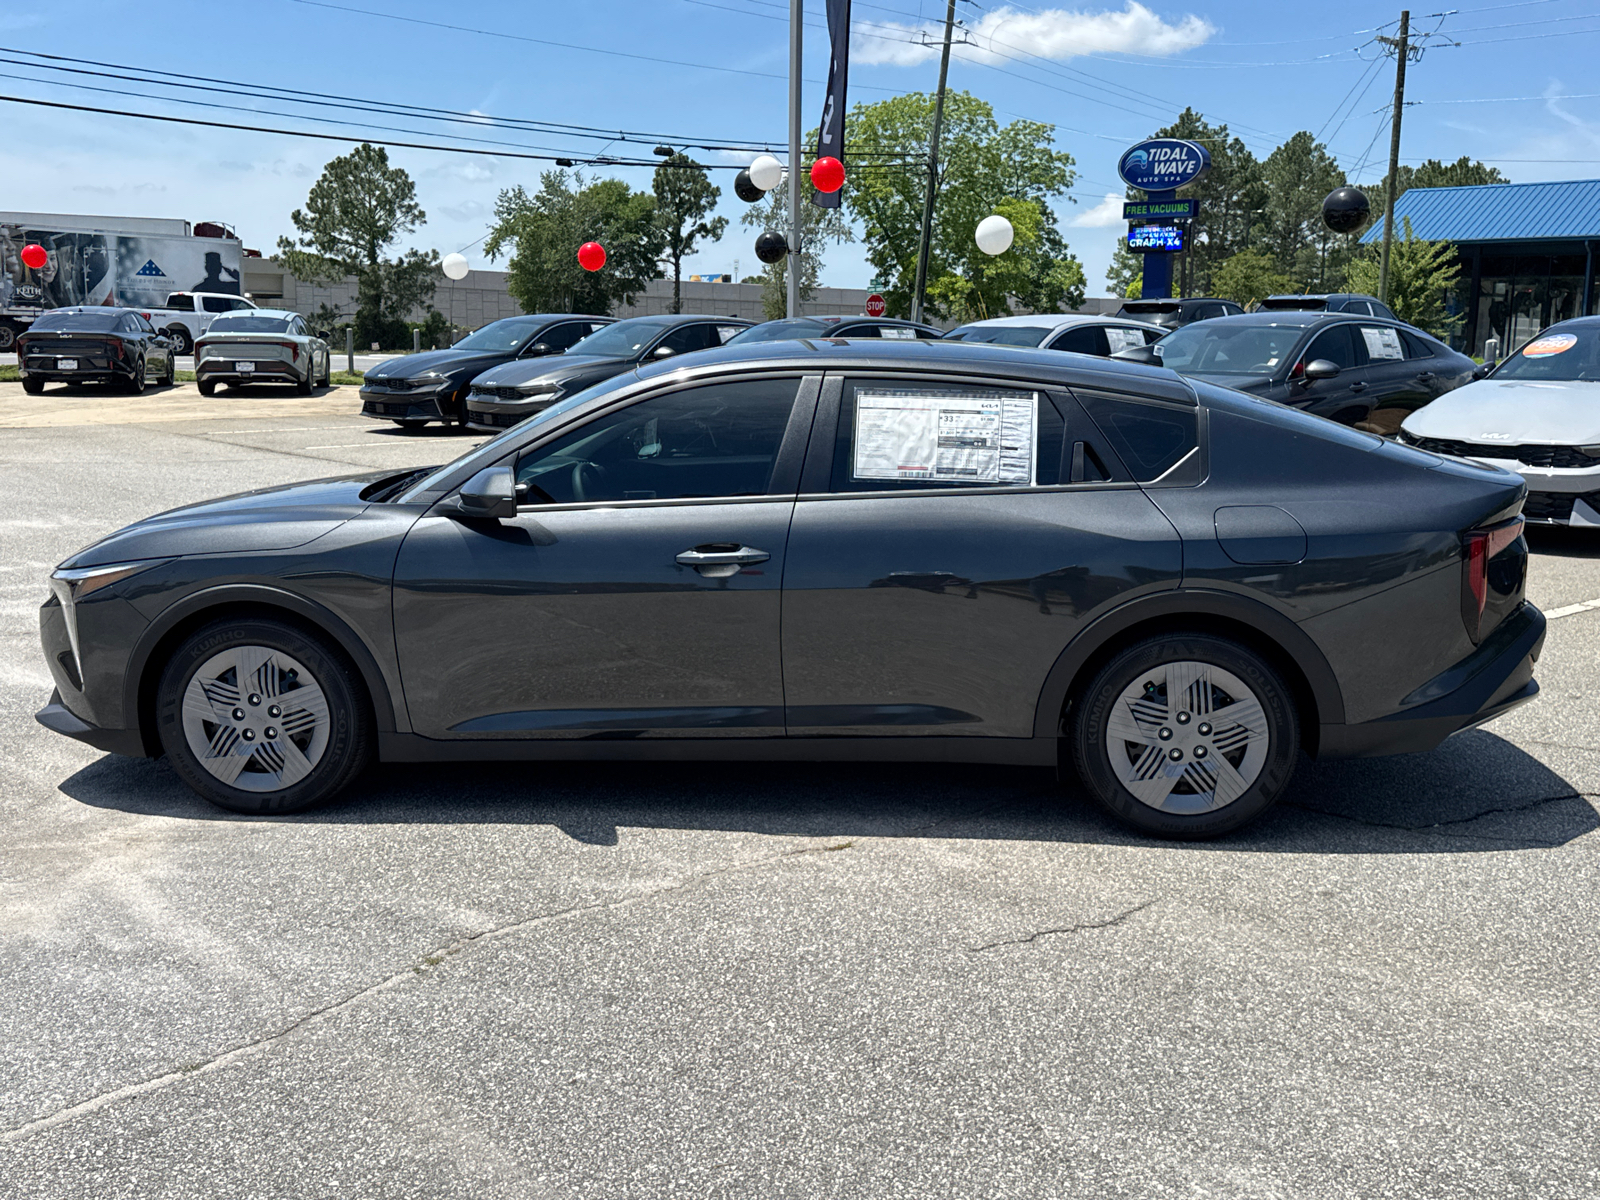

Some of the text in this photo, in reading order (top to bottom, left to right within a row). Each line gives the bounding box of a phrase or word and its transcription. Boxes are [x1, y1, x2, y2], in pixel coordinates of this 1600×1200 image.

[1148, 147, 1188, 162] TIDAL
[1154, 160, 1196, 175] WAVE
[1125, 202, 1190, 215] FREE VACUUMS
[16, 287, 41, 296] KEITH
[867, 301, 885, 311] STOP
[190, 629, 246, 659] KUMHO
[1236, 659, 1281, 709] SOLUS
[1088, 684, 1113, 744] KUMHO
[330, 708, 347, 764] SOLUS
